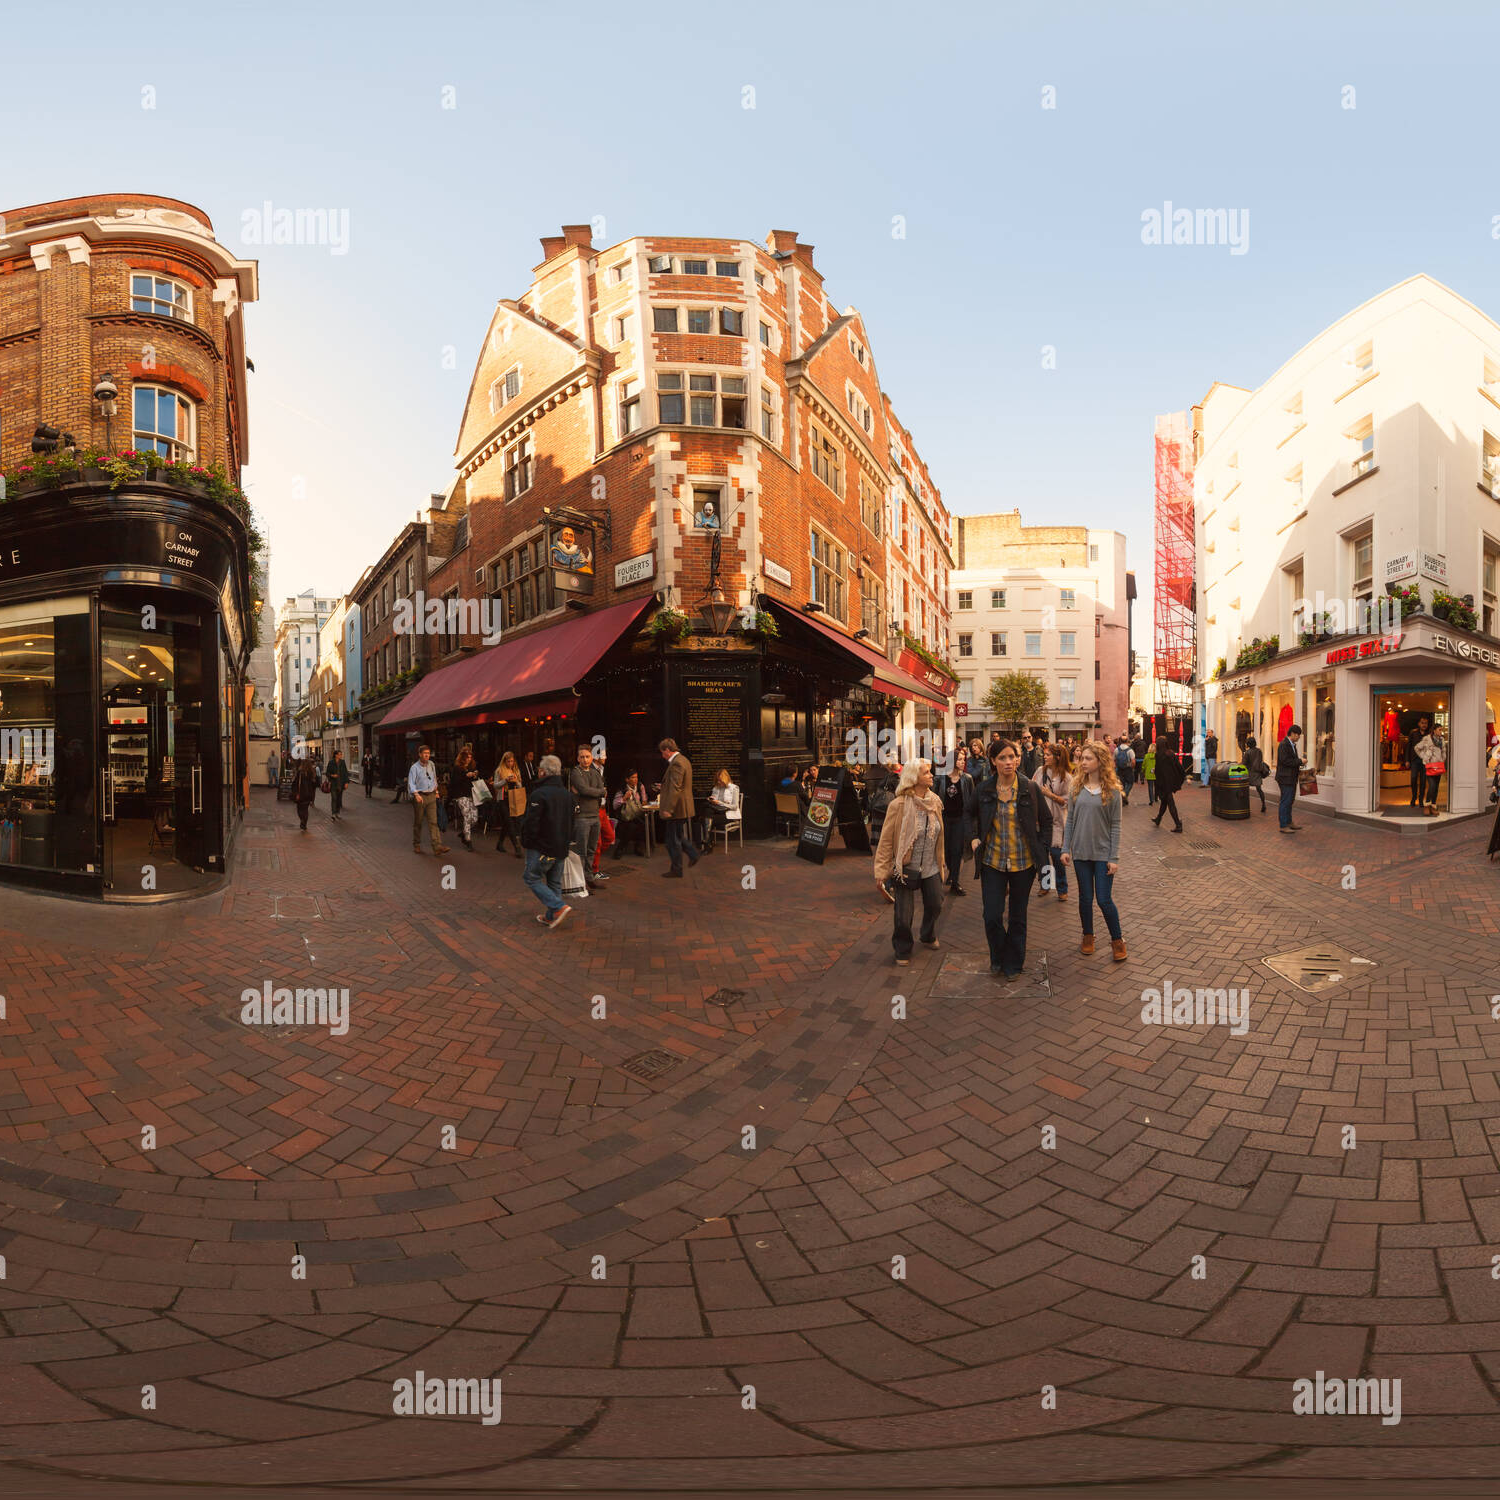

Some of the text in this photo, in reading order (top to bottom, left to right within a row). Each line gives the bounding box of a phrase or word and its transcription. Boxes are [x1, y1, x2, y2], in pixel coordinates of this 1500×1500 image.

[179, 532, 193, 542] ON
[164, 541, 200, 557] CARNABY
[168, 555, 194, 568] STREET
[617, 559, 650, 577] FOUBERTS
[1386, 555, 1409, 568] CARNABY
[1387, 564, 1404, 575] STREET
[1326, 633, 1404, 665] MISS SIXTY
